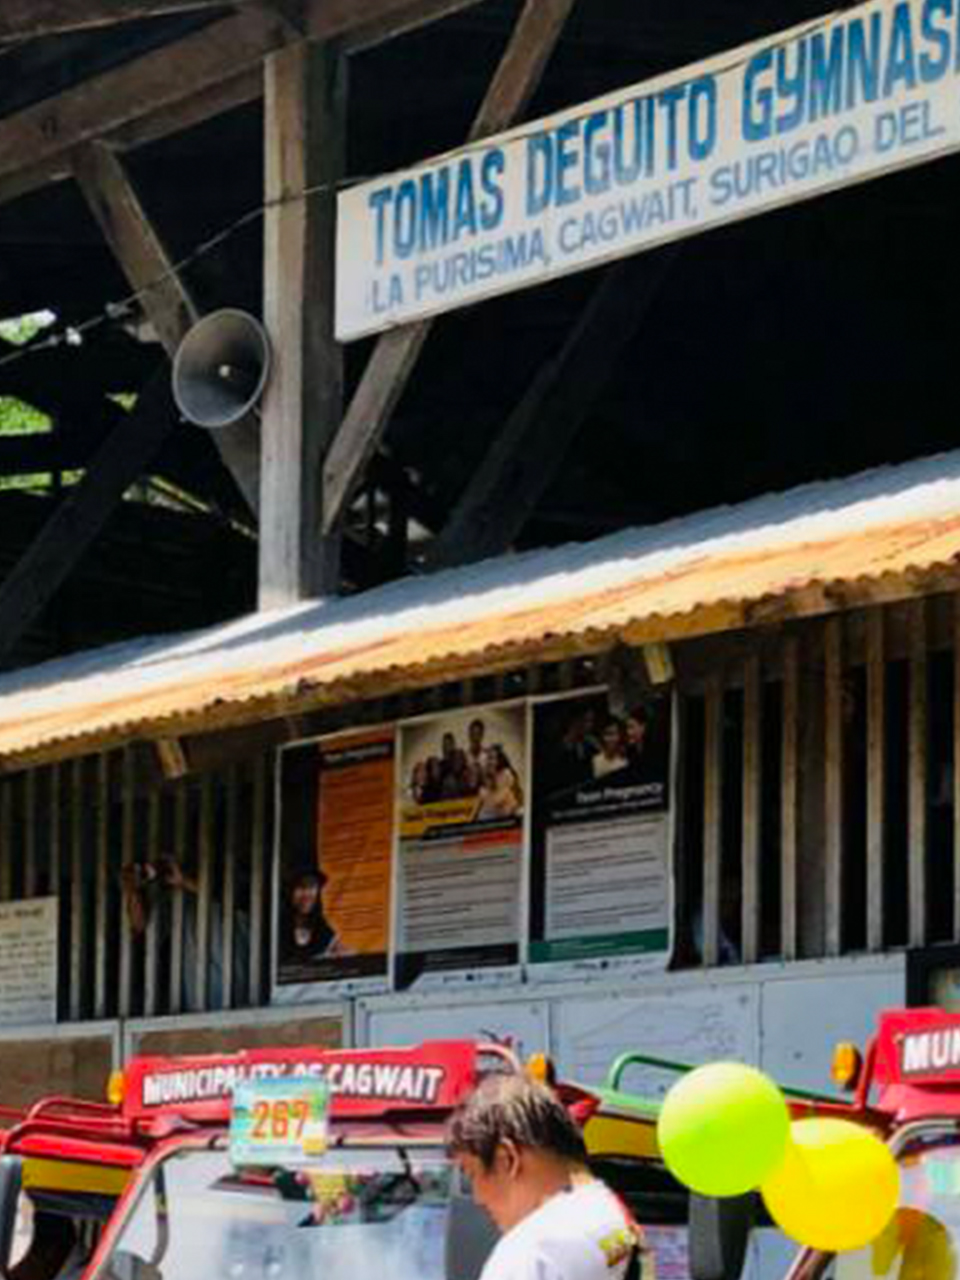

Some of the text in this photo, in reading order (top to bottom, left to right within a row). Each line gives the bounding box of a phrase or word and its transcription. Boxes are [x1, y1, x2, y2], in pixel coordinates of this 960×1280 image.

[368, 148, 505, 268] TOMAS
[526, 76, 718, 218] DEGUITO
[371, 275, 404, 313] LA
[709, 126, 860, 206] SURIGAO
[874, 99, 945, 153] DEL
[327, 1063, 444, 1101] CAGWAIT
